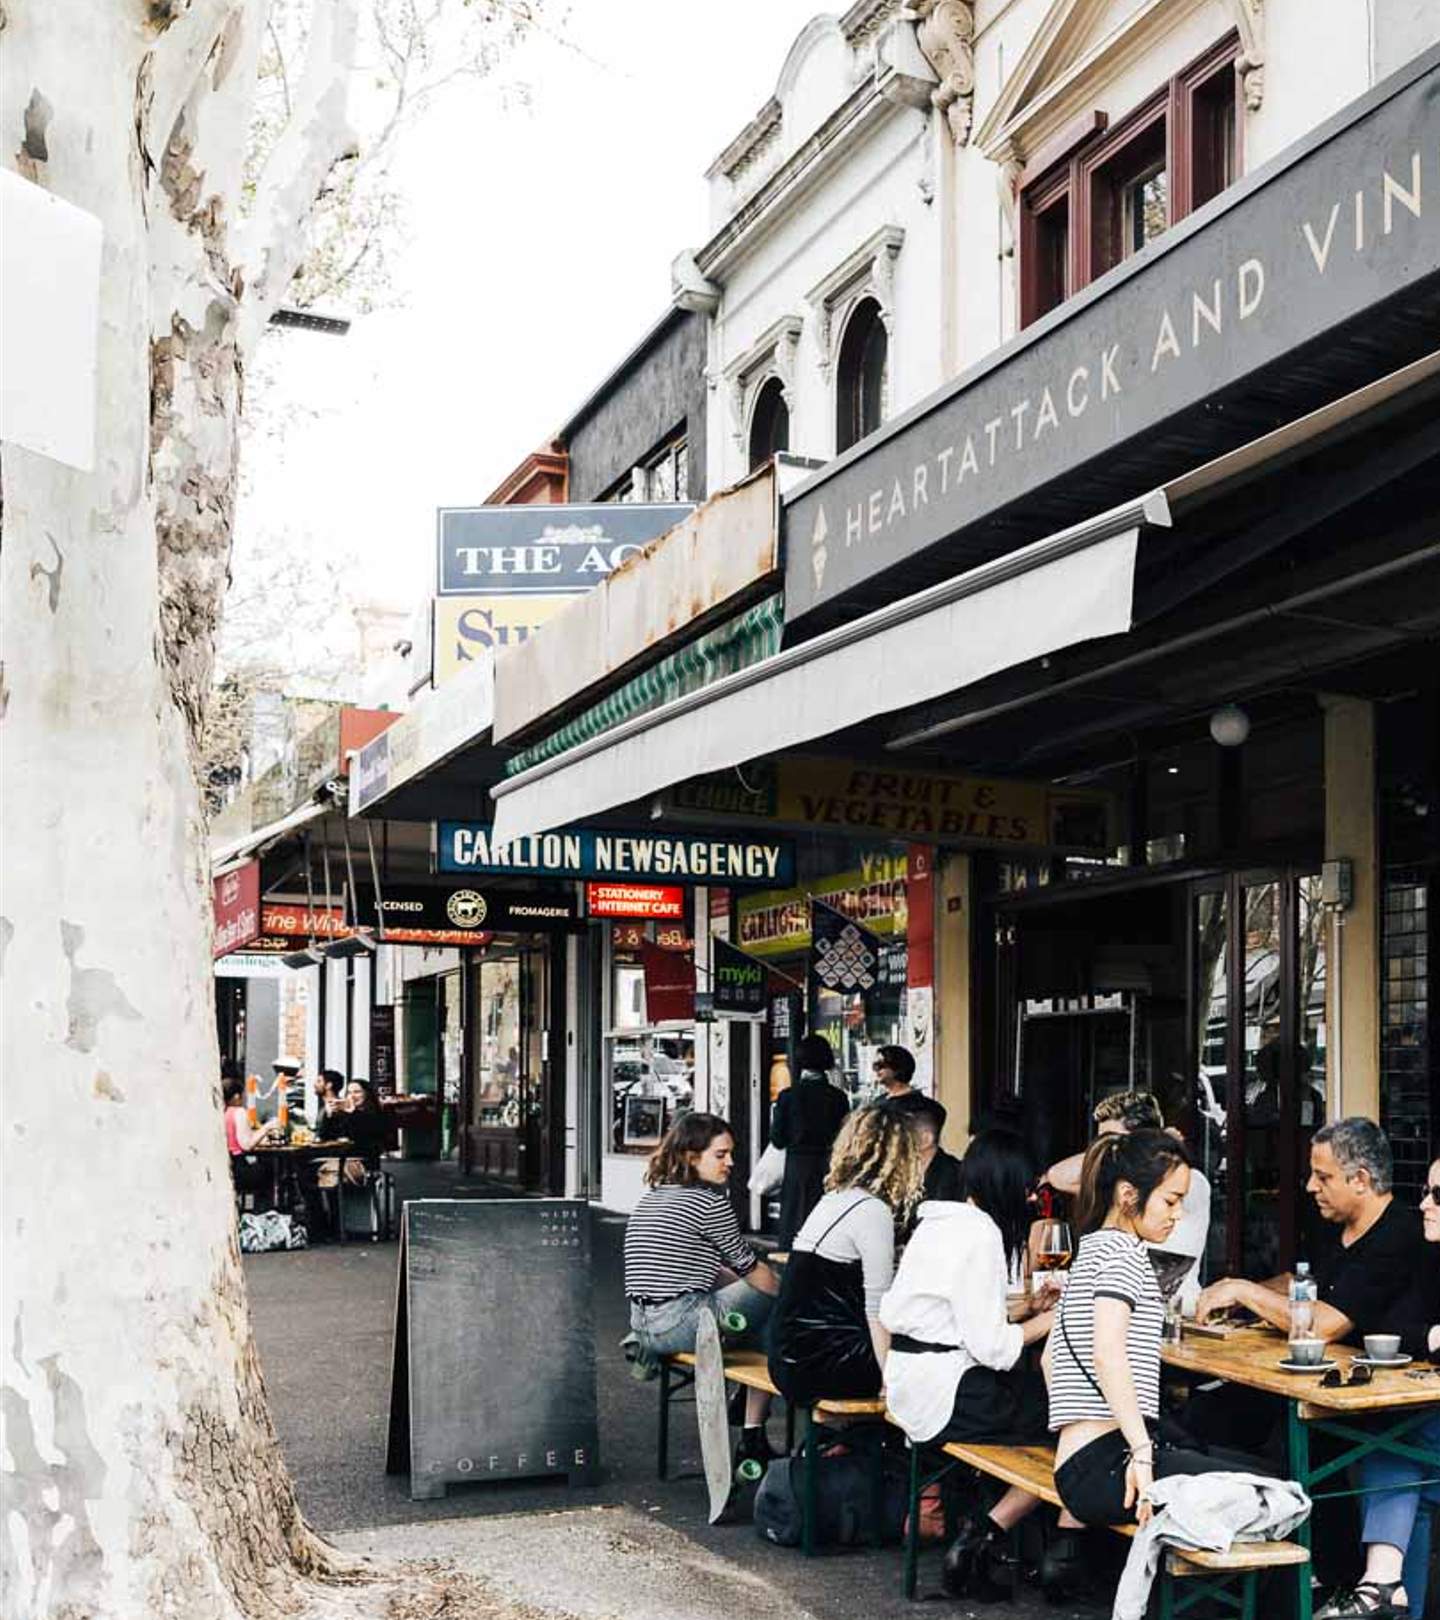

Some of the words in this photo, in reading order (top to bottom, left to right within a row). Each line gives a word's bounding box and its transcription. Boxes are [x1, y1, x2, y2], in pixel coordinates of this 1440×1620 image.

[844, 343, 1123, 548] HEARTATTACK
[1150, 258, 1265, 372] AND
[456, 546, 562, 575] THE
[848, 770, 961, 803] FRUIT
[802, 795, 1028, 840] VEGETABLES
[453, 829, 581, 870] CARLTON
[595, 837, 779, 878] NEWSAGENCY
[597, 887, 663, 900] STATIONERY
[508, 906, 570, 918] FROMAGERIE
[597, 901, 651, 913] INTERNET
[652, 903, 680, 914] CAFE
[719, 966, 762, 985] myki
[427, 1449, 585, 1475] COFFEE
